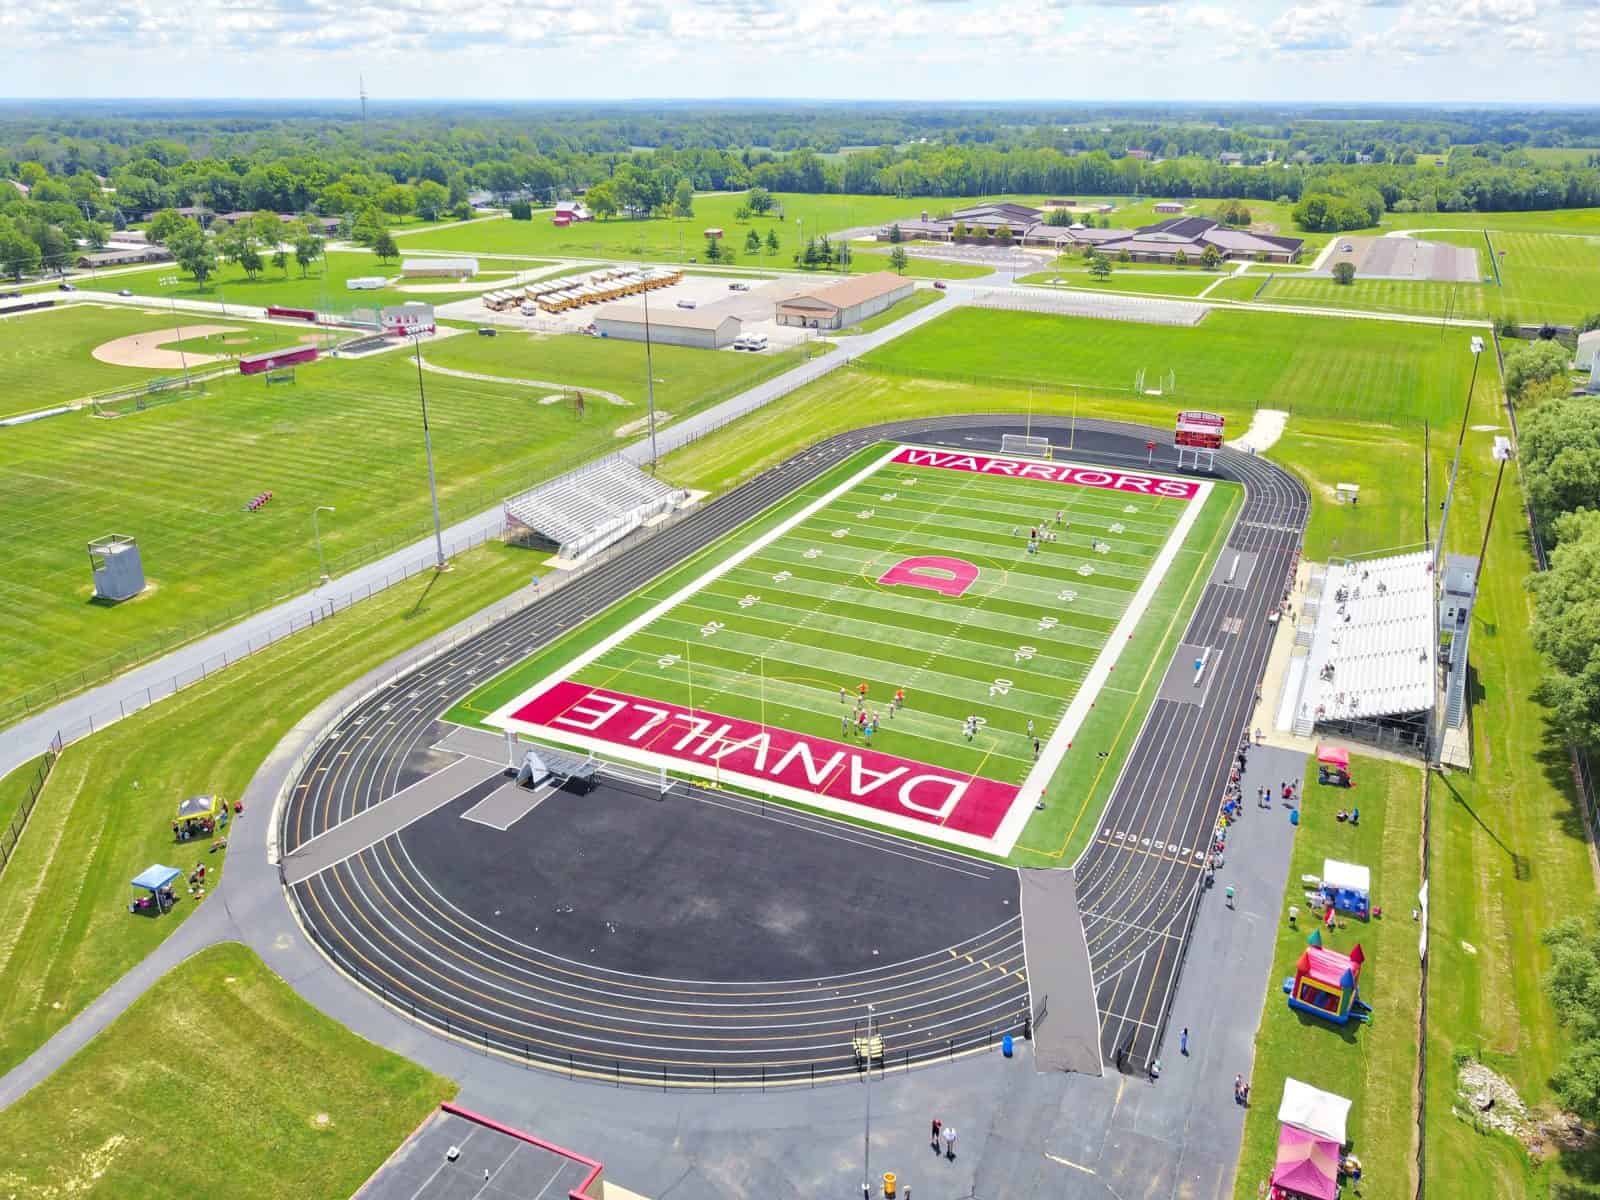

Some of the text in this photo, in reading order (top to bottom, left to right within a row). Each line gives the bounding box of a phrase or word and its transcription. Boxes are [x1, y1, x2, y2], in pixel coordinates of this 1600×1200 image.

[907, 451, 1190, 497] WARRIORS
[879, 556, 980, 597] D
[1014, 646, 1037, 660] 30
[989, 678, 1013, 696] 20
[553, 692, 970, 819] DANVILLE
[1114, 831, 1125, 840] 2
